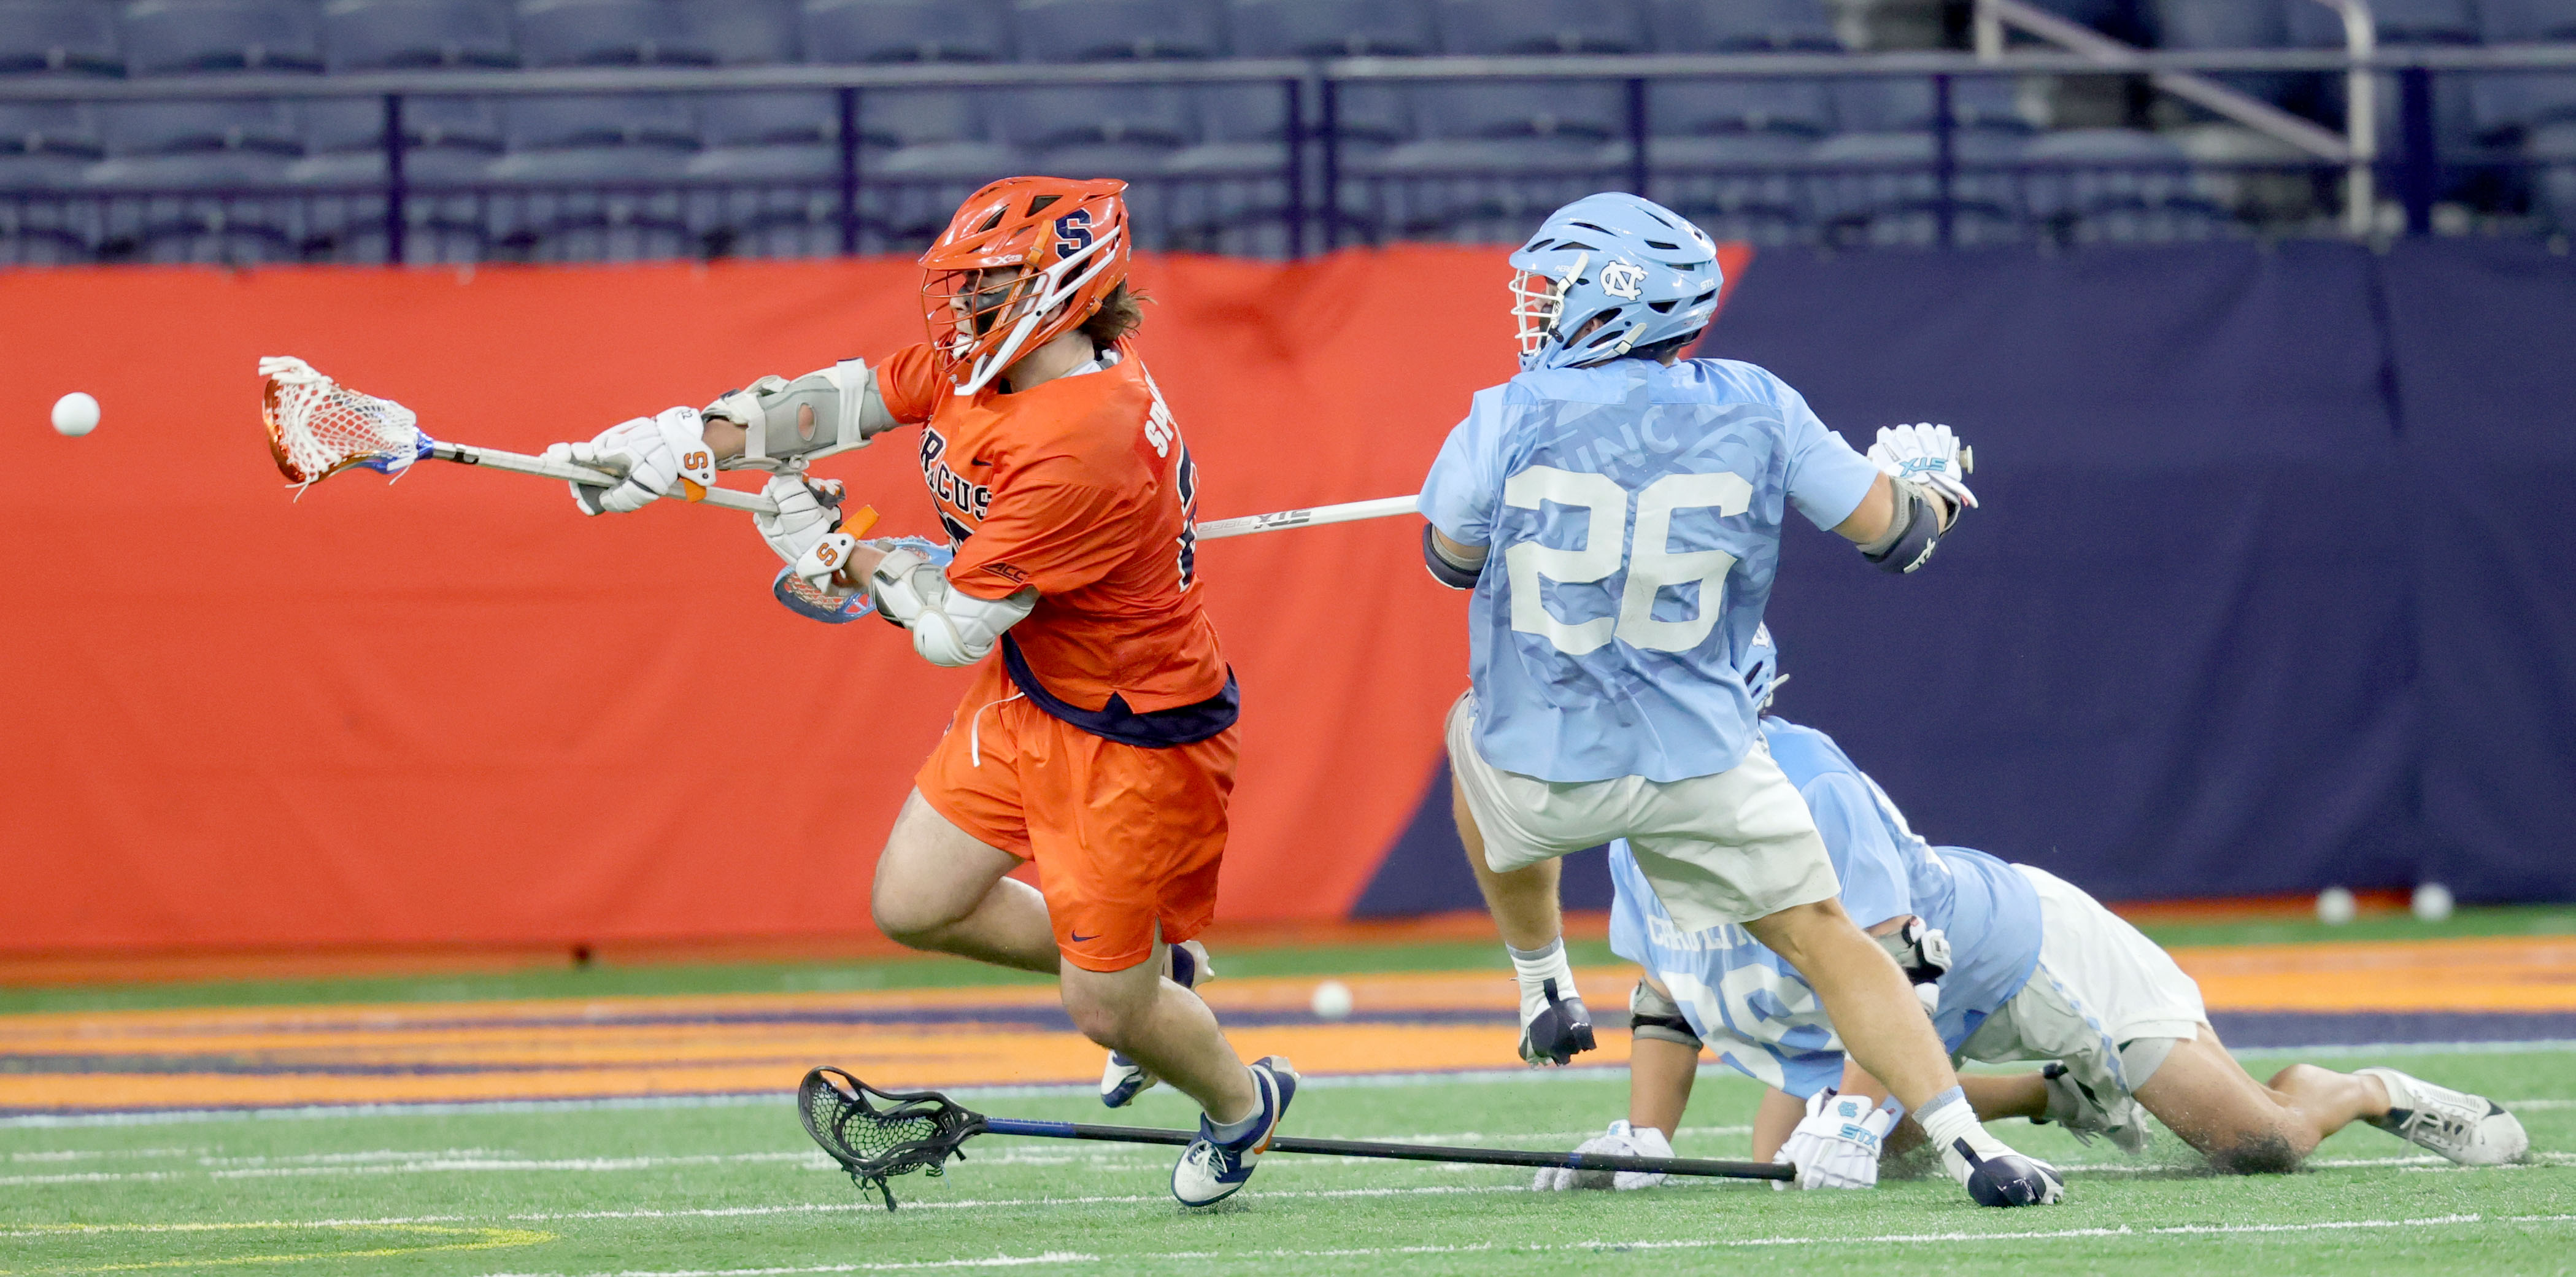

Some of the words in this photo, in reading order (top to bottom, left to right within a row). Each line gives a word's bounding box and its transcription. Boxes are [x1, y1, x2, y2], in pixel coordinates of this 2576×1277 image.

[1054, 207, 1094, 261] S
[1700, 277, 1716, 291] STX
[684, 451, 709, 471] S
[1899, 457, 1949, 478] STX
[1198, 516, 1252, 532] FIBER
[1253, 507, 1312, 530] STX
[816, 542, 838, 567] S
[1505, 465, 1753, 656] 26
[984, 563, 1029, 582] ACC
[1838, 1123, 1878, 1150] STX
